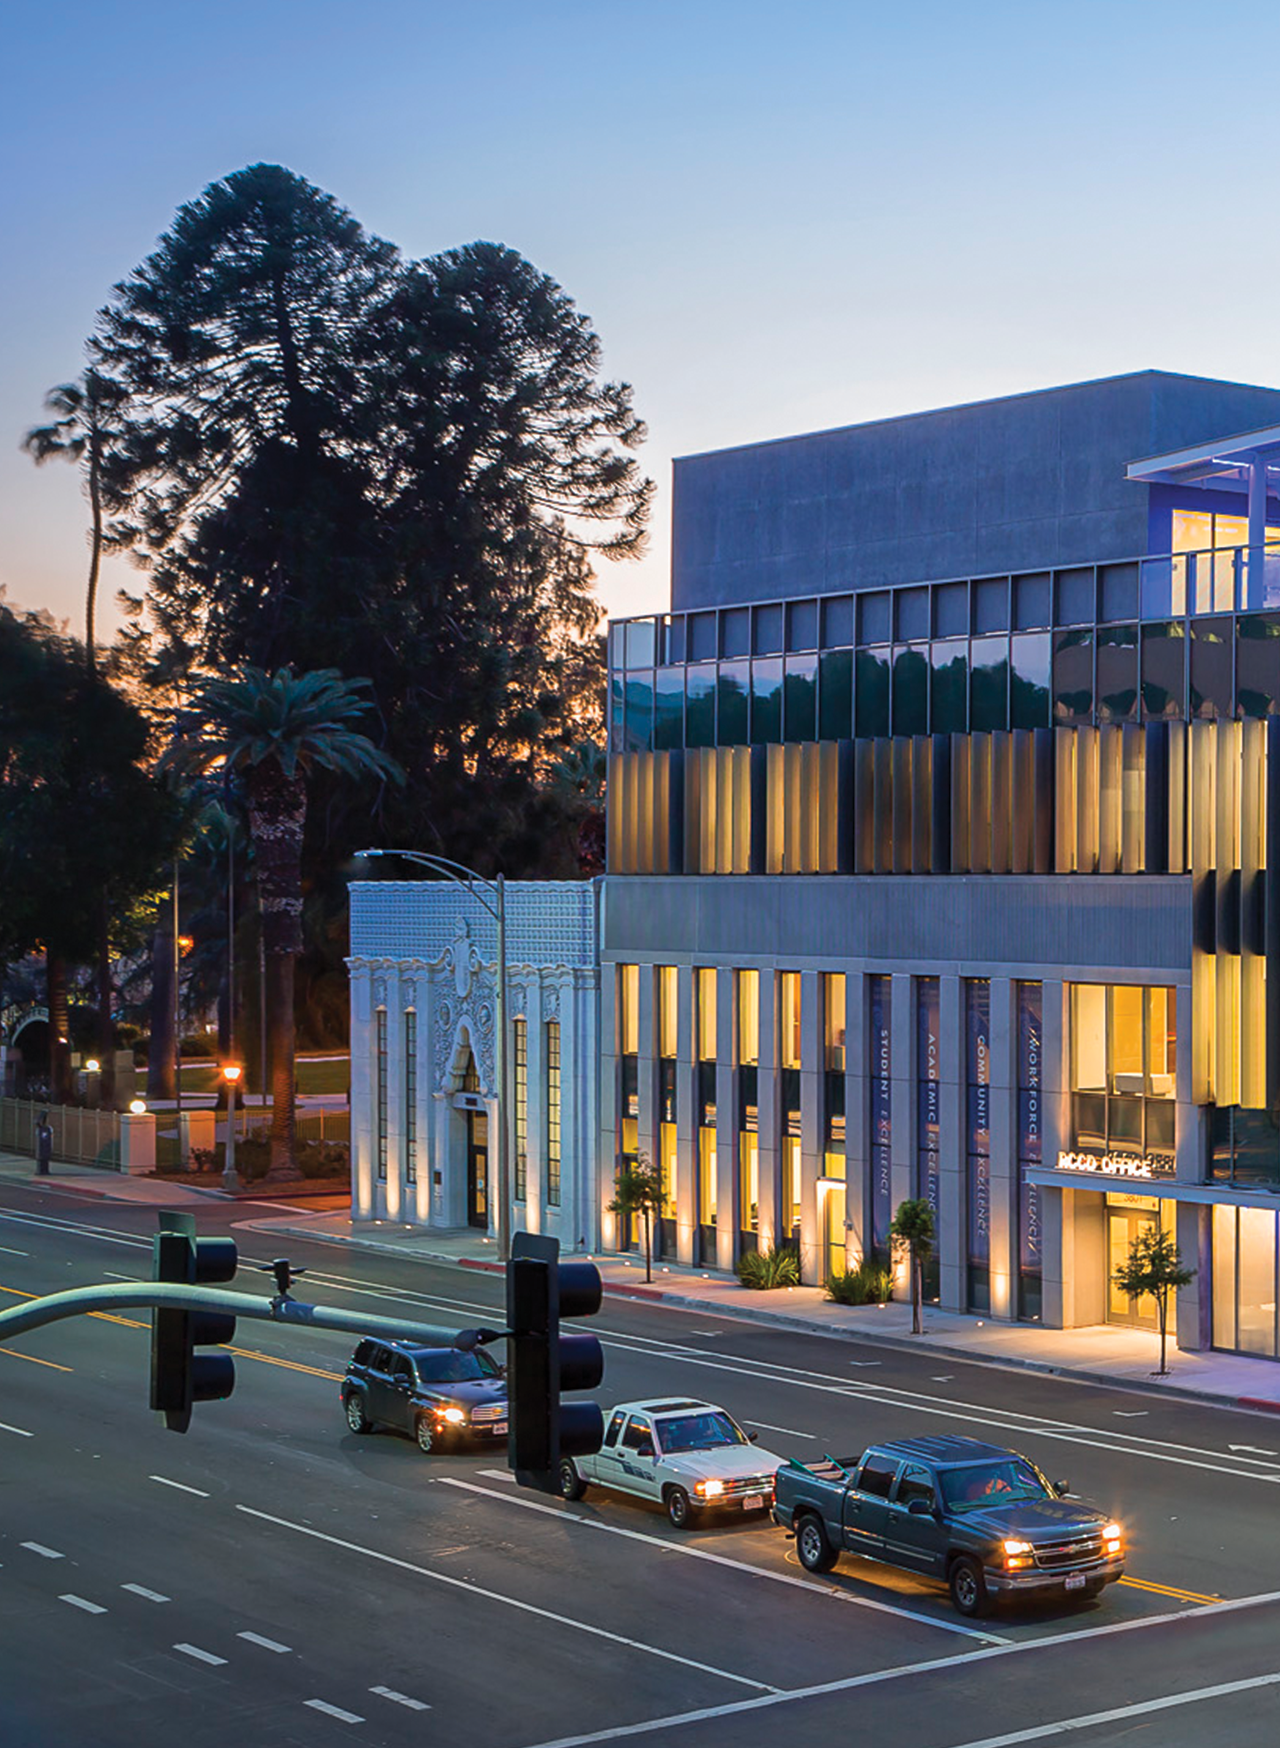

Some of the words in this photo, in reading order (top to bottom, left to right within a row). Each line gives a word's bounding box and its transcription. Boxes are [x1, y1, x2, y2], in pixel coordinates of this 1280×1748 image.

[881, 1029, 889, 1100] STUDENT
[928, 1033, 936, 1122] ACADEMIC
[977, 1034, 986, 1137] COMMUNITY
[1028, 1038, 1037, 1143] WORKFORCE
[881, 1110, 889, 1196] EXCELLENCE
[977, 1148, 986, 1237] EXCELLENCE
[1057, 1151, 1097, 1171] RCCD
[1101, 1156, 1152, 1178] OFFICE
